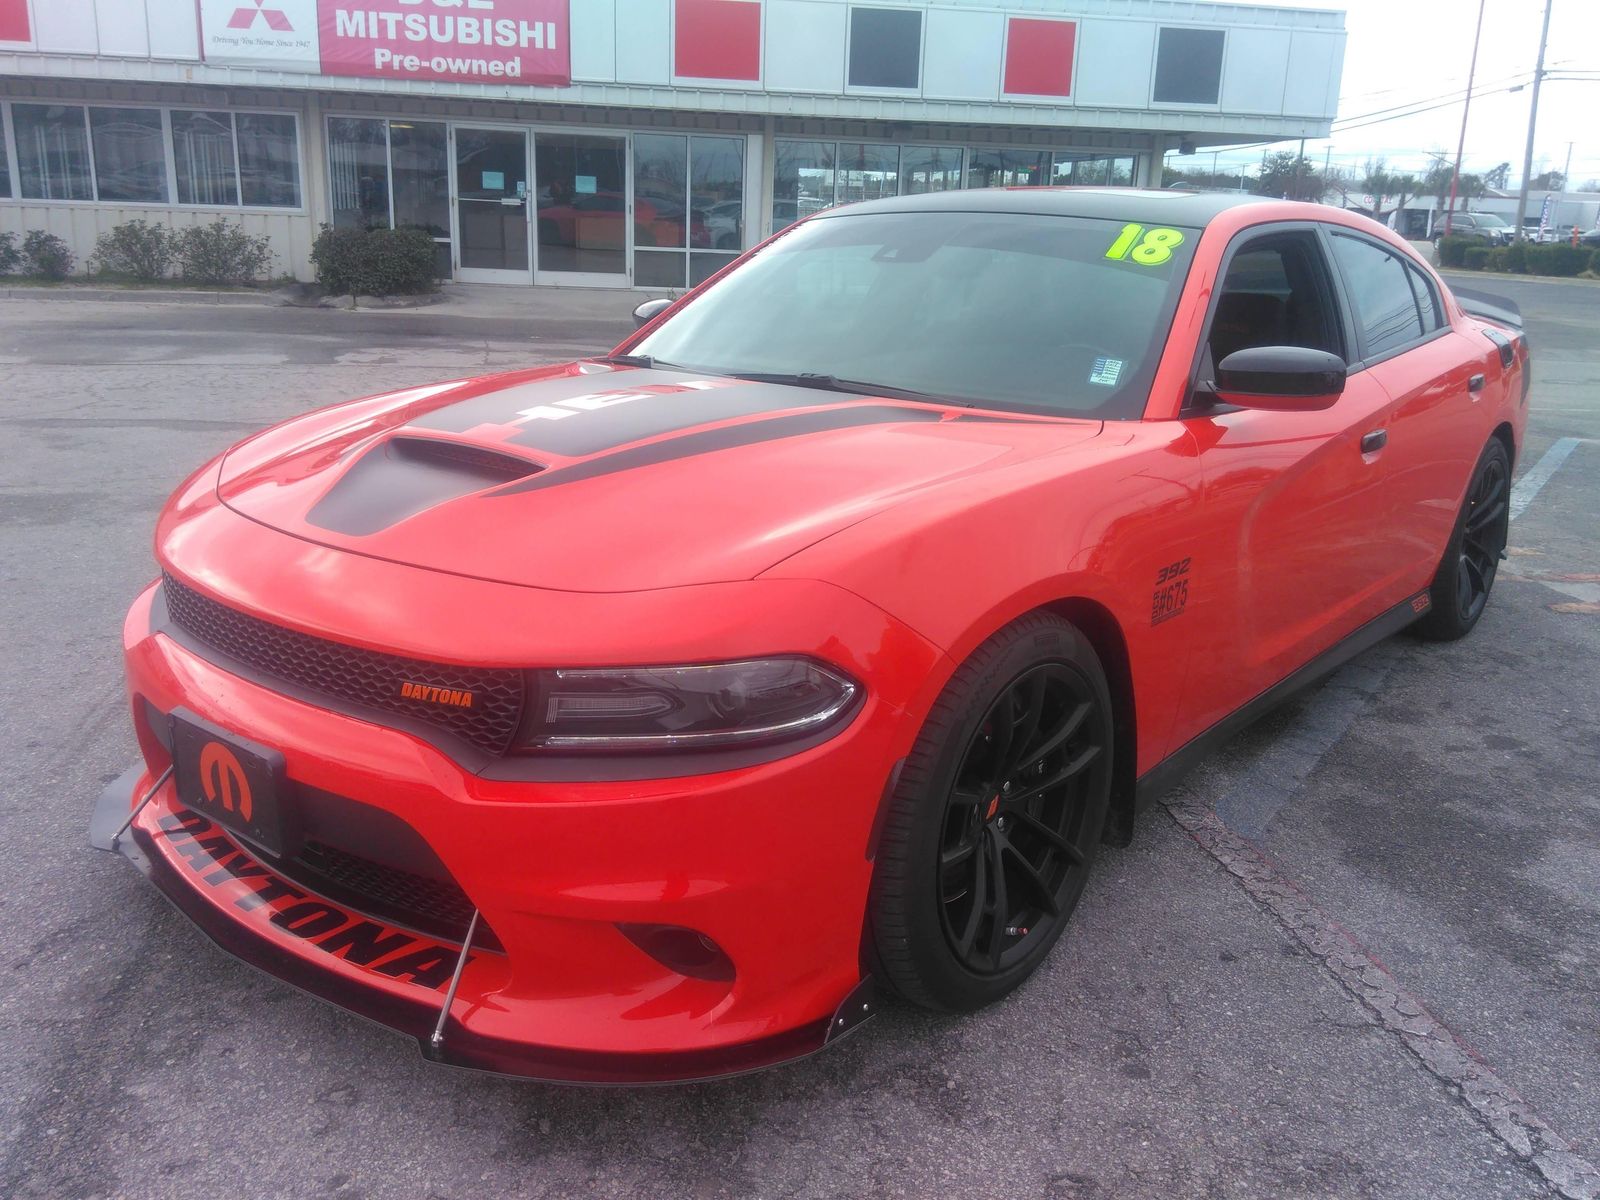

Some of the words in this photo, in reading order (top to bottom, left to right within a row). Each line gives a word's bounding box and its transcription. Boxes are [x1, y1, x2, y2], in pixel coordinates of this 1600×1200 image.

[213, 36, 239, 47] Driving
[241, 37, 254, 46] You
[256, 38, 274, 46] Home
[276, 39, 294, 47] Since
[335, 9, 556, 50] MITSUBISHI
[374, 48, 521, 77] Pre-owned
[1104, 223, 1184, 266] 18
[1156, 557, 1191, 586] 392
[401, 682, 472, 708] DAYTONA
[156, 809, 476, 991] DAYTONA
